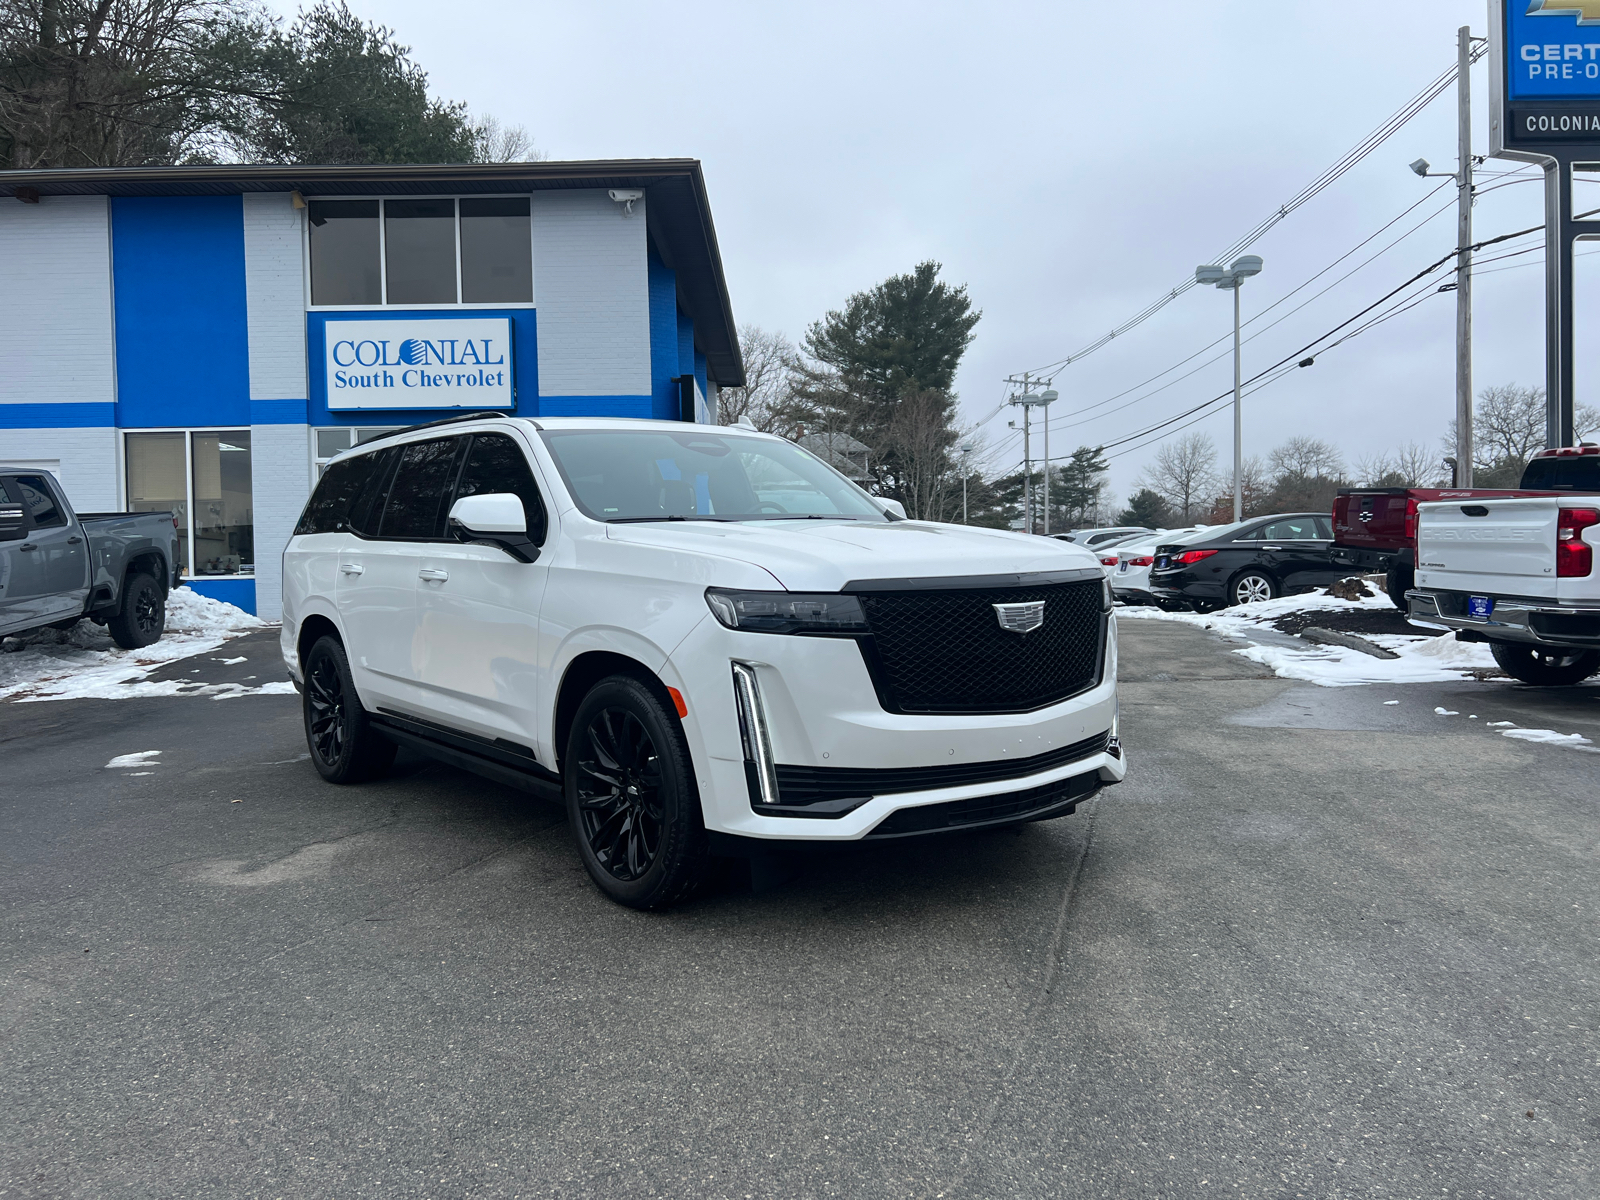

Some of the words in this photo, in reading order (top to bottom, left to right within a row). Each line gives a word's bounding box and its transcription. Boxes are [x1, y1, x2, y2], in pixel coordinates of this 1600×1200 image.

[1520, 43, 1600, 61] CERT
[1529, 63, 1599, 79] PRE-O
[1526, 115, 1600, 131] COLONIA
[332, 338, 504, 367] COLONIAL
[335, 370, 395, 388] South
[401, 369, 504, 387] Chevrolet
[1422, 528, 1542, 541] CHEVROLET
